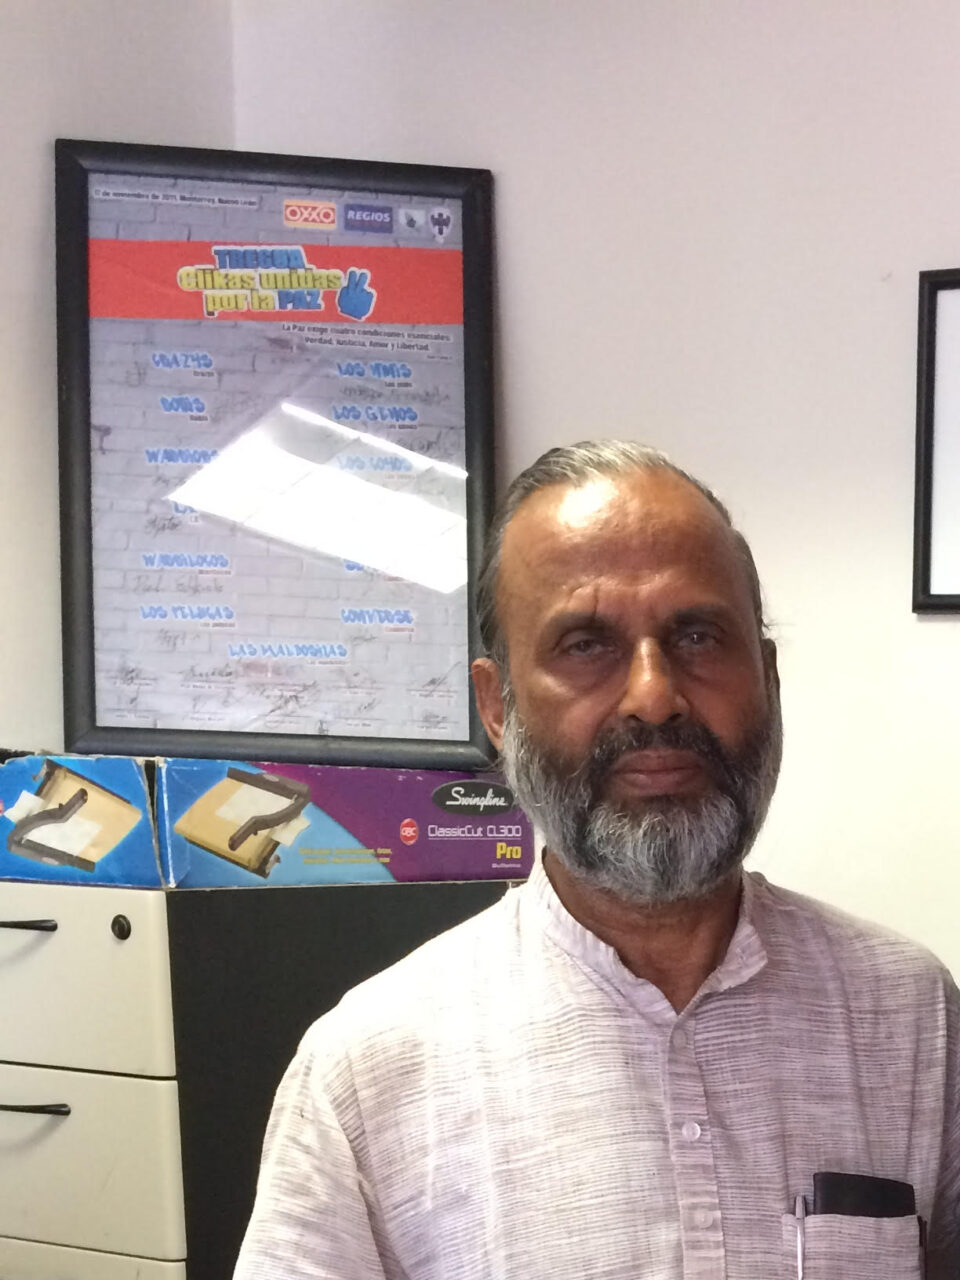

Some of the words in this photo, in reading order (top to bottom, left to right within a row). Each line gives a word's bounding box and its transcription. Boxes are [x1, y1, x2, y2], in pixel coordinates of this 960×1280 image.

[285, 205, 336, 223] OXXO
[347, 210, 391, 223] REGIOS
[213, 249, 305, 269] TREGUA
[178, 269, 254, 290] Clikas
[259, 271, 341, 290] unidas
[205, 292, 247, 316] por
[250, 291, 275, 310] la
[276, 290, 322, 310] PAZ
[445, 786, 508, 812] Swingline
[427, 824, 483, 838] ClassicCut
[486, 824, 522, 838] CL300
[495, 842, 522, 860] Pro
